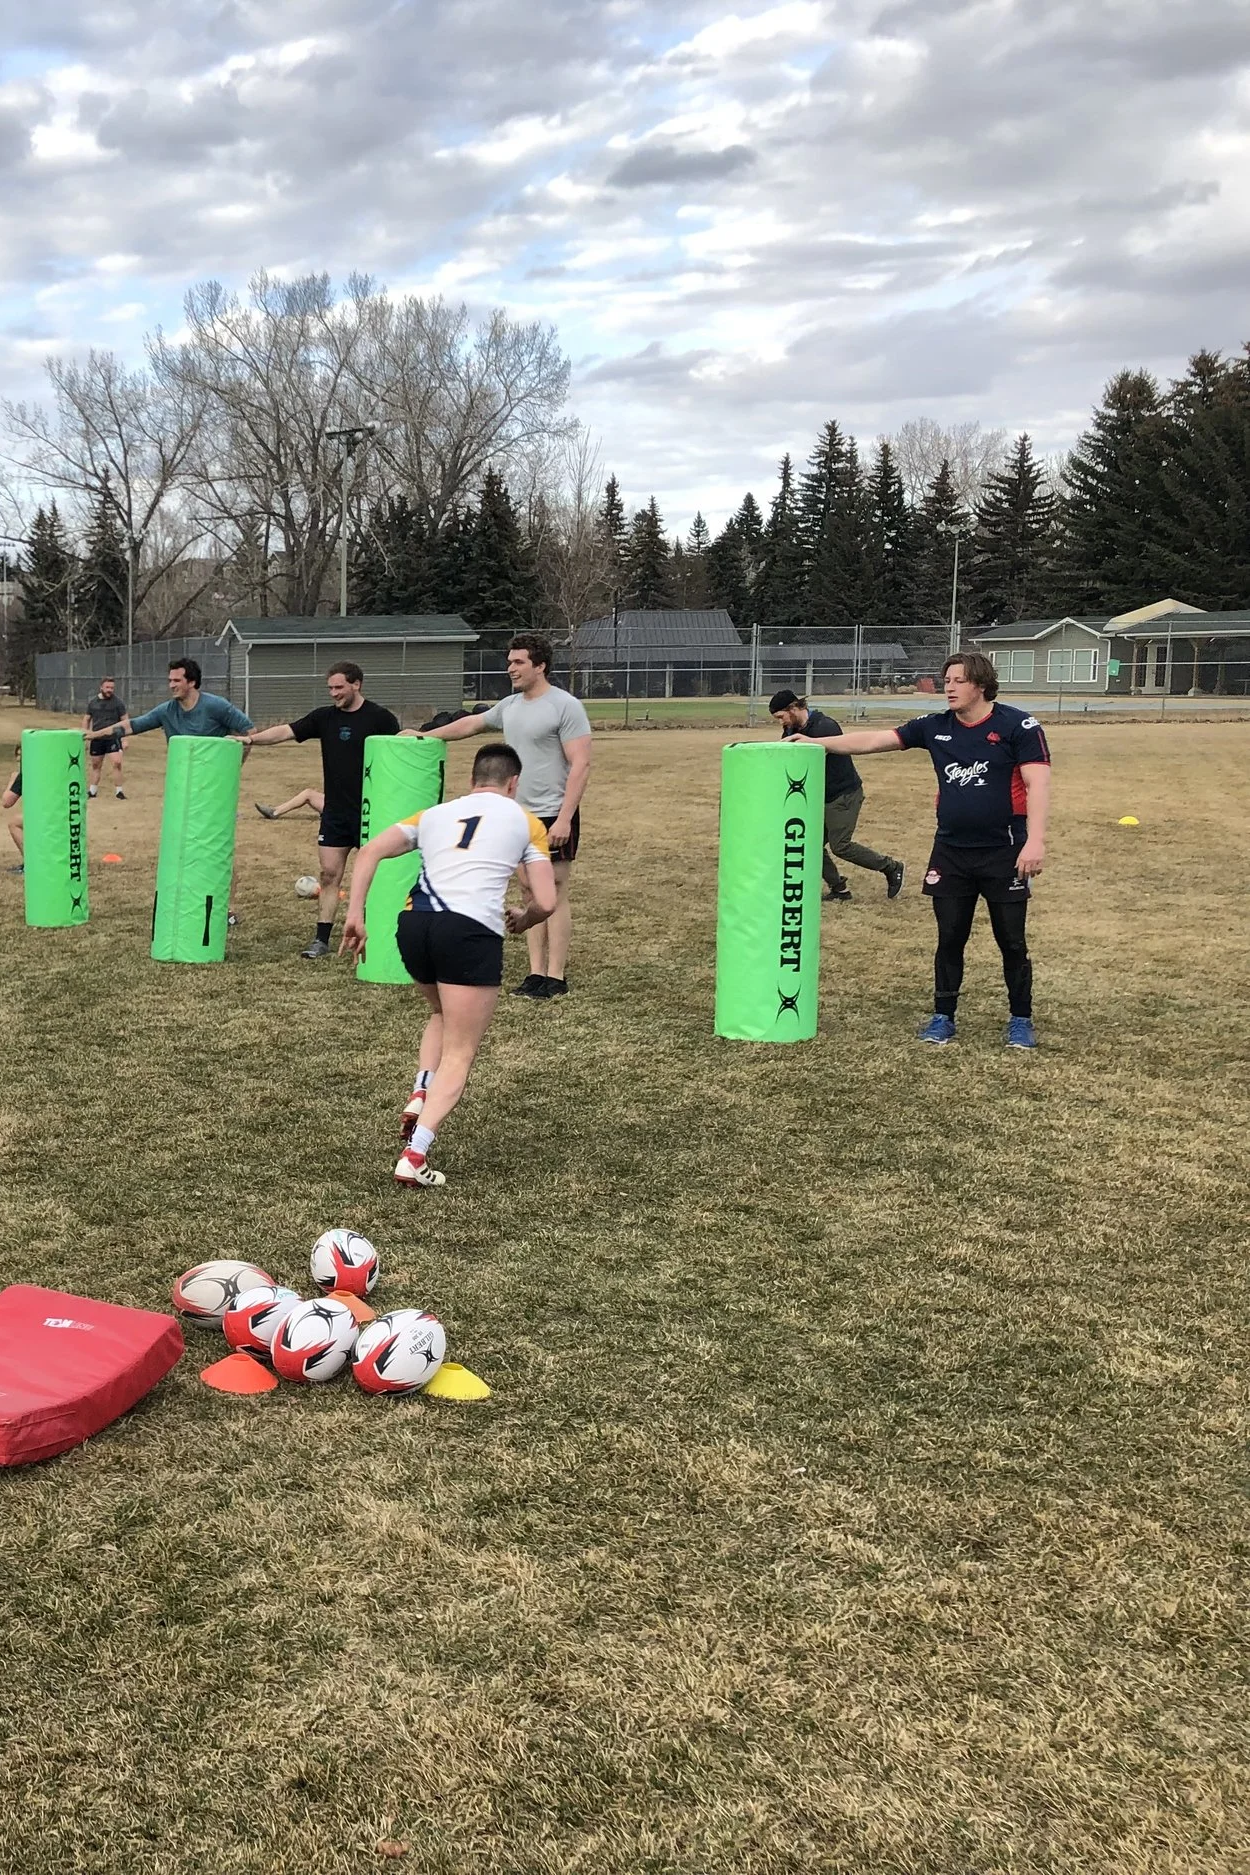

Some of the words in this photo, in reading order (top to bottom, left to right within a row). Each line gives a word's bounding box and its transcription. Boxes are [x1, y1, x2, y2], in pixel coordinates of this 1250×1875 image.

[944, 760, 990, 787] Steggles
[68, 781, 82, 882] GILBERT
[455, 814, 485, 851] 1
[780, 817, 806, 973] GILBERT
[409, 1330, 434, 1355] GILBERT
